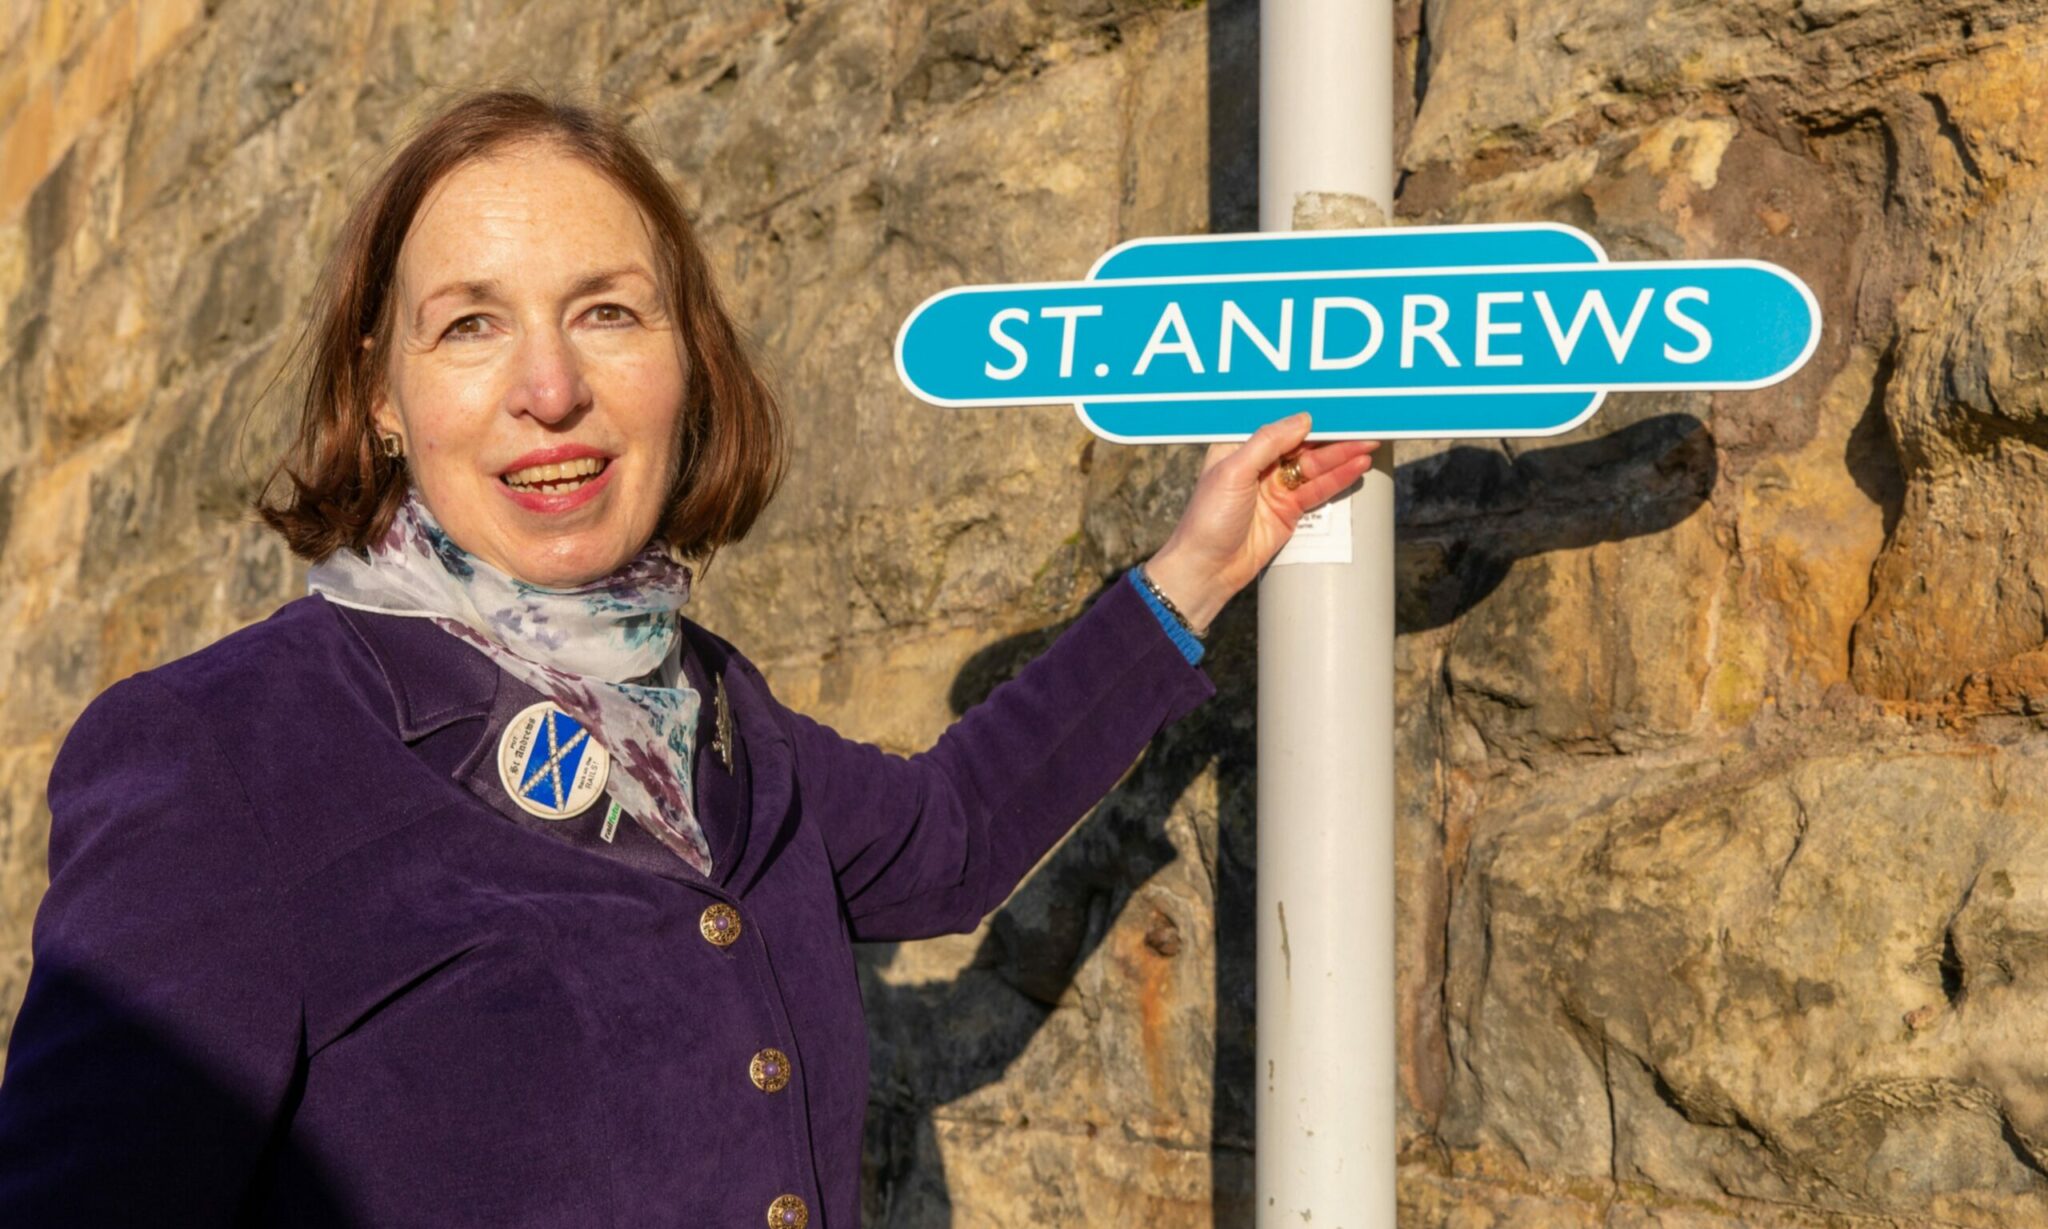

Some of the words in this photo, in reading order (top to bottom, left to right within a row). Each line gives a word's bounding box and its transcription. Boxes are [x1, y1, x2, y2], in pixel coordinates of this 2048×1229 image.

[985, 305, 1109, 381] ST.
[1132, 286, 1713, 376] ANDREWS
[509, 761, 520, 774] St
[515, 717, 536, 759] Andrews
[585, 761, 600, 789] RAILS!
